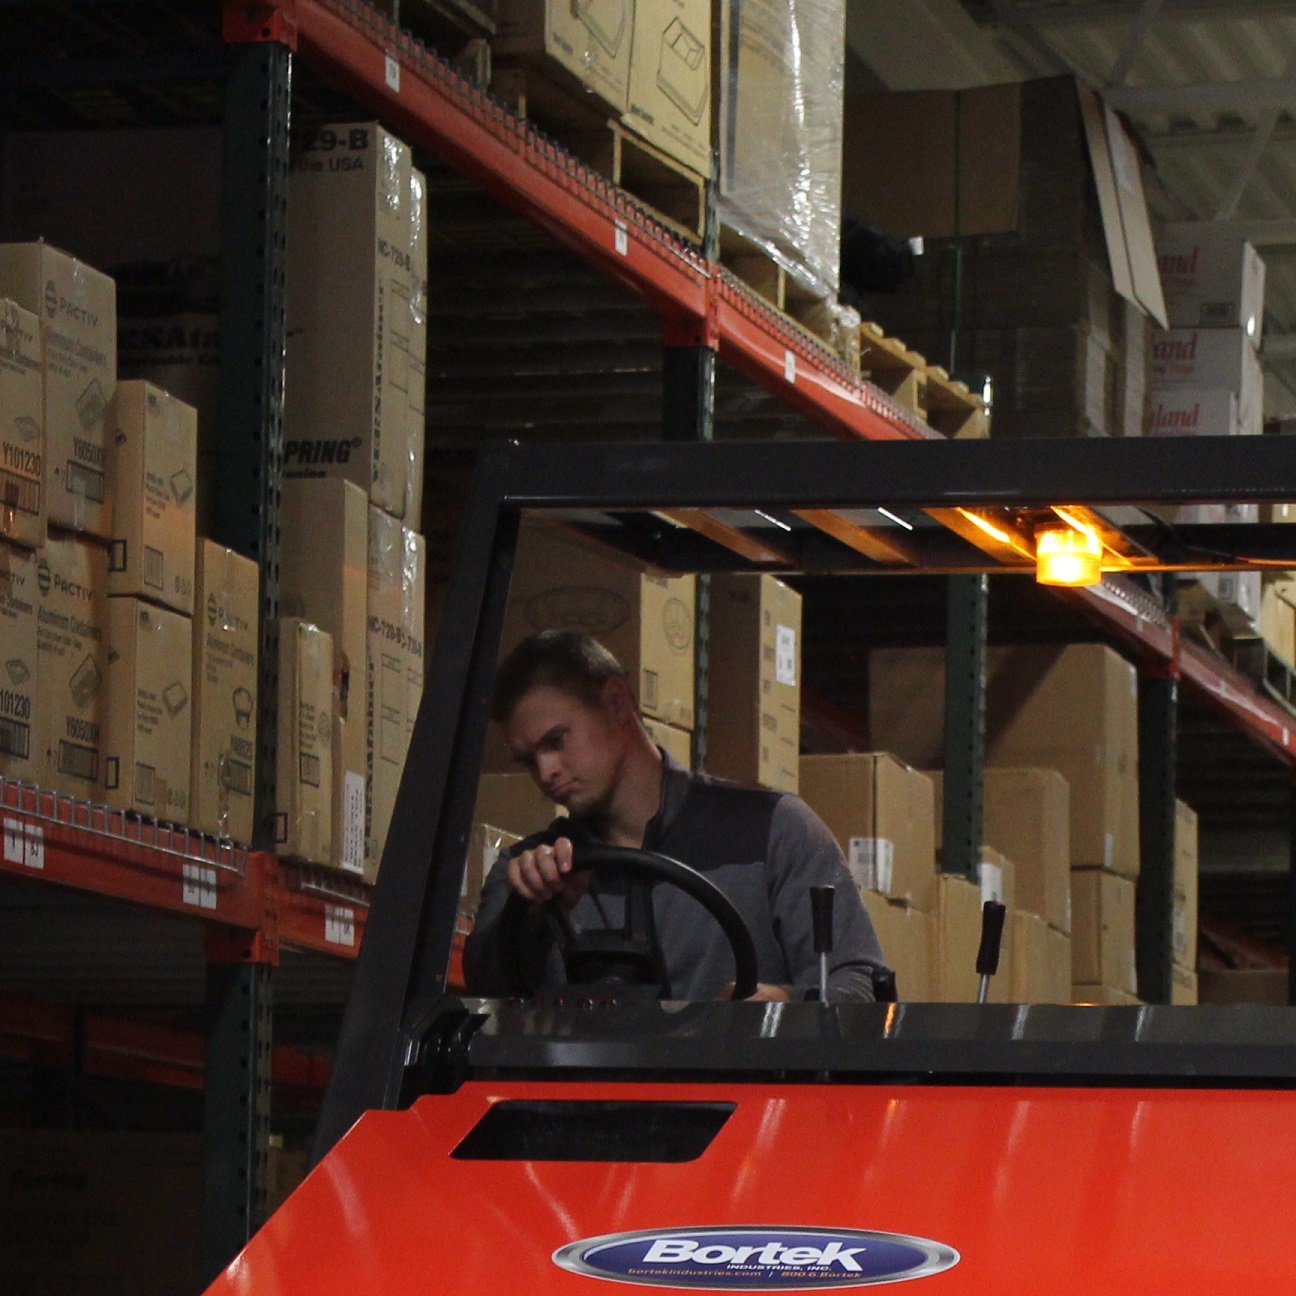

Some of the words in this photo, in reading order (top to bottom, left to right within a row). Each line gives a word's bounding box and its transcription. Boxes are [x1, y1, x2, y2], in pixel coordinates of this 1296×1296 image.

[329, 156, 365, 172] USA
[54, 574, 94, 602] PACTIV
[642, 1239, 867, 1272] Bortek
[627, 1267, 762, 1278] bortekindustries.com
[726, 1263, 805, 1272] INDUSTRIES,
[806, 1264, 833, 1273] INC.
